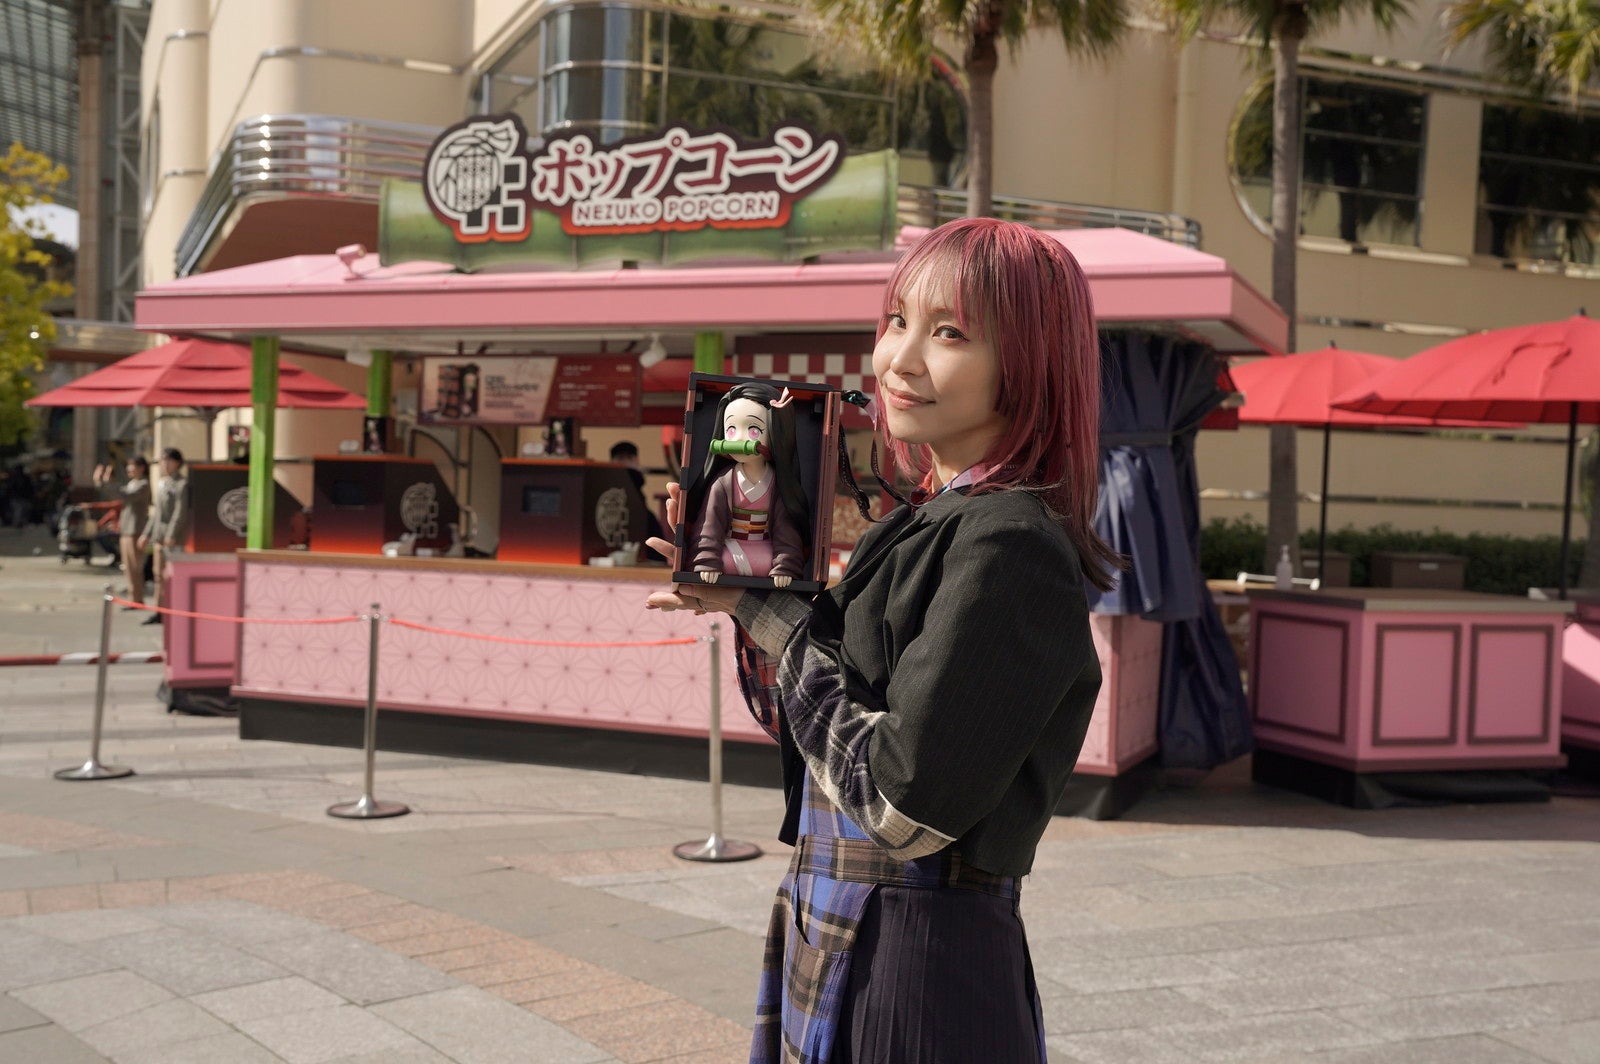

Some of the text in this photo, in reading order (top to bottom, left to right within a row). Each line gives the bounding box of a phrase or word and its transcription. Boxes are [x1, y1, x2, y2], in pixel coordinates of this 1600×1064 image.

[535, 130, 835, 200] ポップコーン
[575, 195, 777, 222] NEZUKO POPCORN
